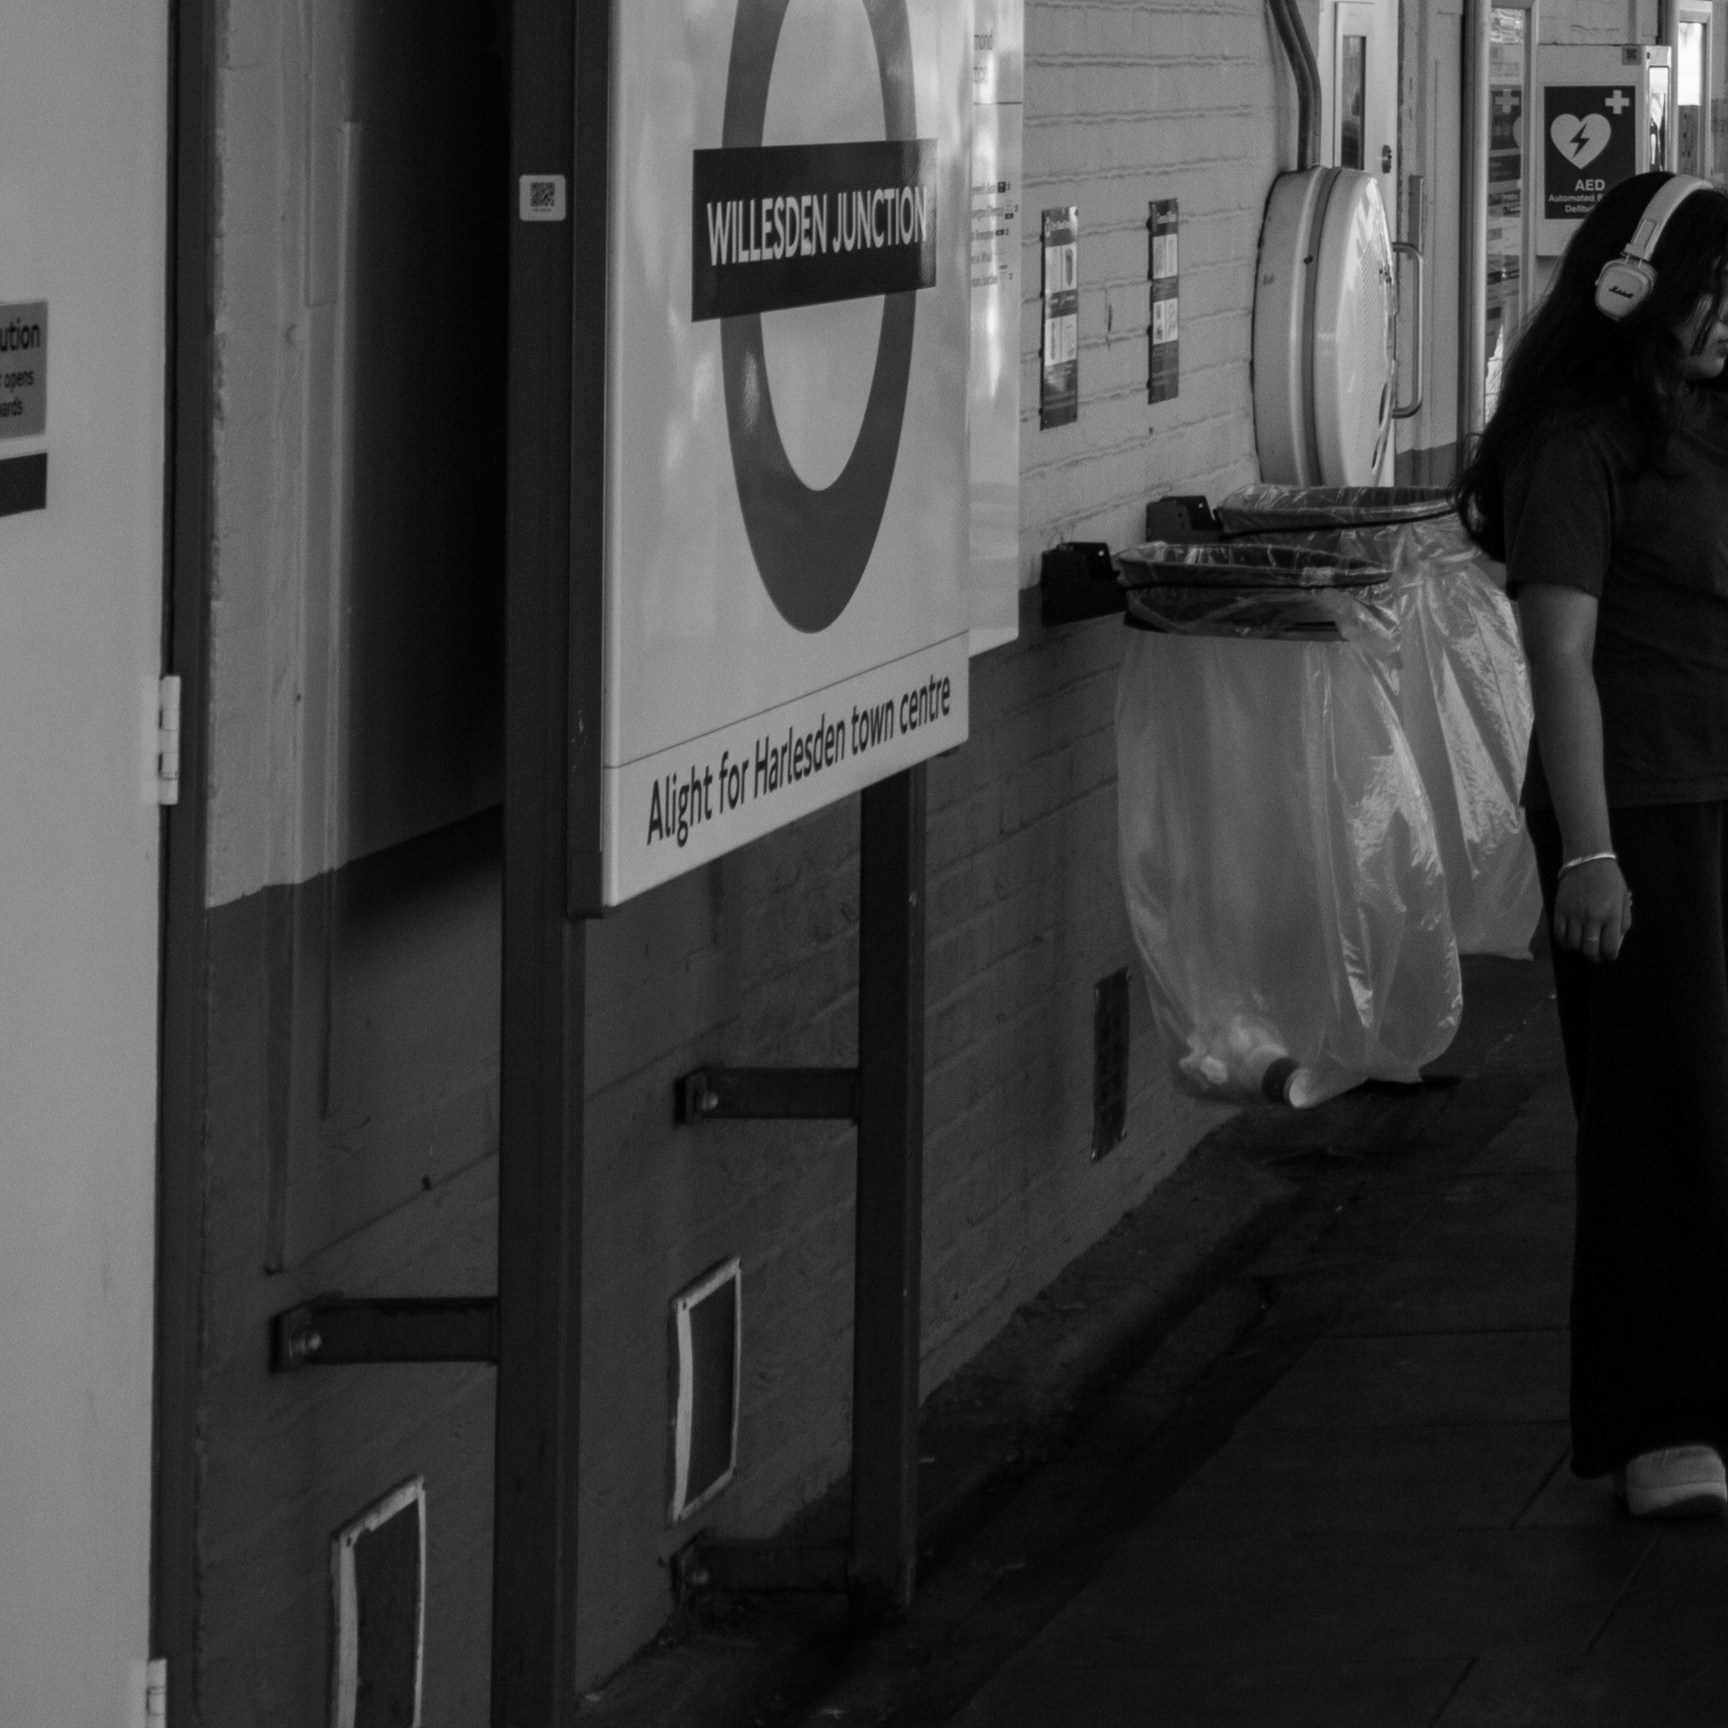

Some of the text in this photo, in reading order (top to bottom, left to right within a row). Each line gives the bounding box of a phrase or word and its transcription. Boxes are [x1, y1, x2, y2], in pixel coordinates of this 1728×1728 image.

[1548, 193, 1595, 203] Automated
[1575, 179, 1605, 191] AED
[706, 186, 927, 266] WILLESDEN JUNCTION
[646, 674, 950, 848] Alight for Harlesden town centre
